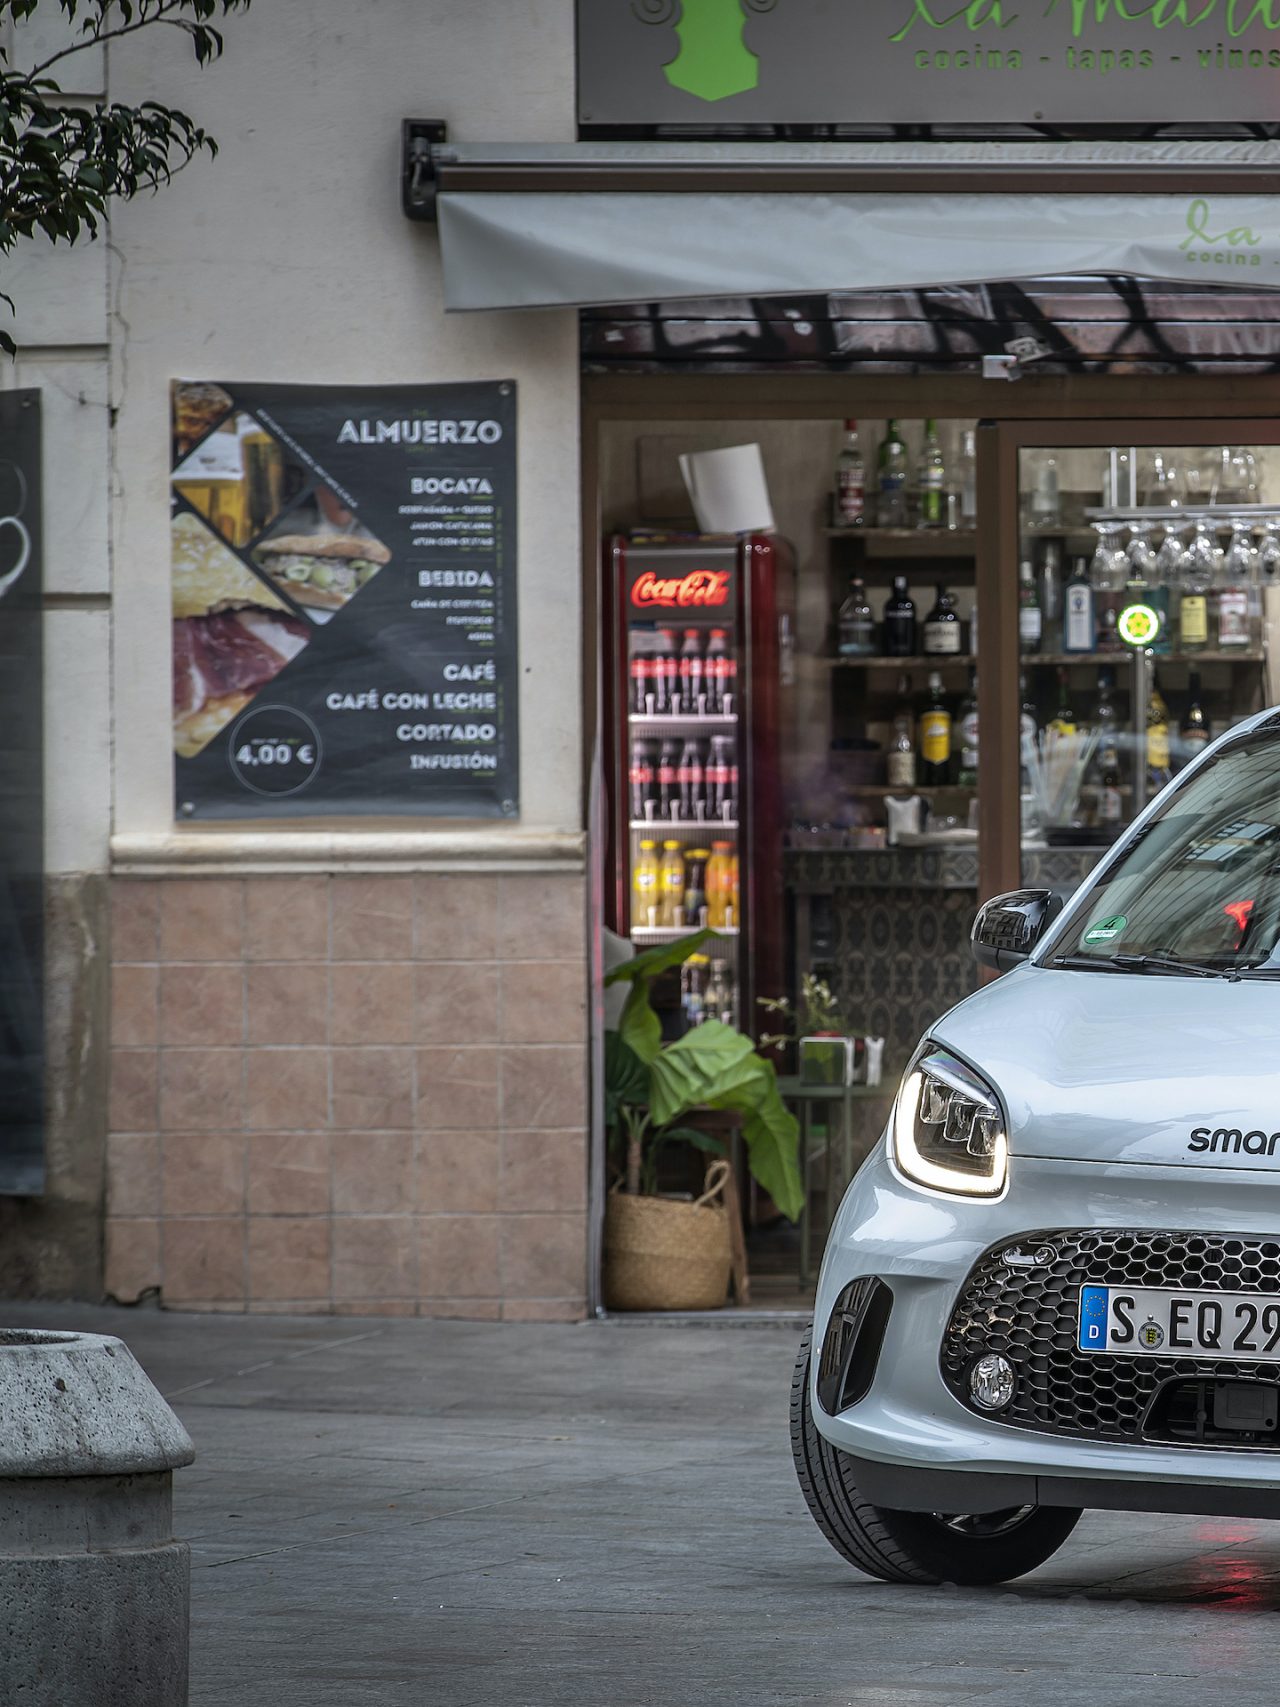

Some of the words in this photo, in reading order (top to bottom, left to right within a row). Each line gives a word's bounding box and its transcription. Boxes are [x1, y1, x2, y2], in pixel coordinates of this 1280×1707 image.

[914, 43, 1023, 69] cocina
[1066, 45, 1153, 75] tapas
[1178, 199, 1262, 250] la
[1186, 249, 1261, 266] cocina
[337, 419, 503, 444] ALMUERZO
[410, 477, 494, 495] BOCATA
[418, 569, 495, 588] BEBIDA
[443, 660, 496, 682] CAFÉ
[326, 688, 379, 710] CAFÉ
[382, 692, 429, 710] CON
[432, 692, 496, 710] LECHE
[396, 723, 497, 742] CORTADO
[410, 750, 498, 770] INFUSIÓN
[1088, 1324, 1100, 1339] D
[1110, 1295, 1135, 1343] S
[1168, 1298, 1222, 1349] EQ
